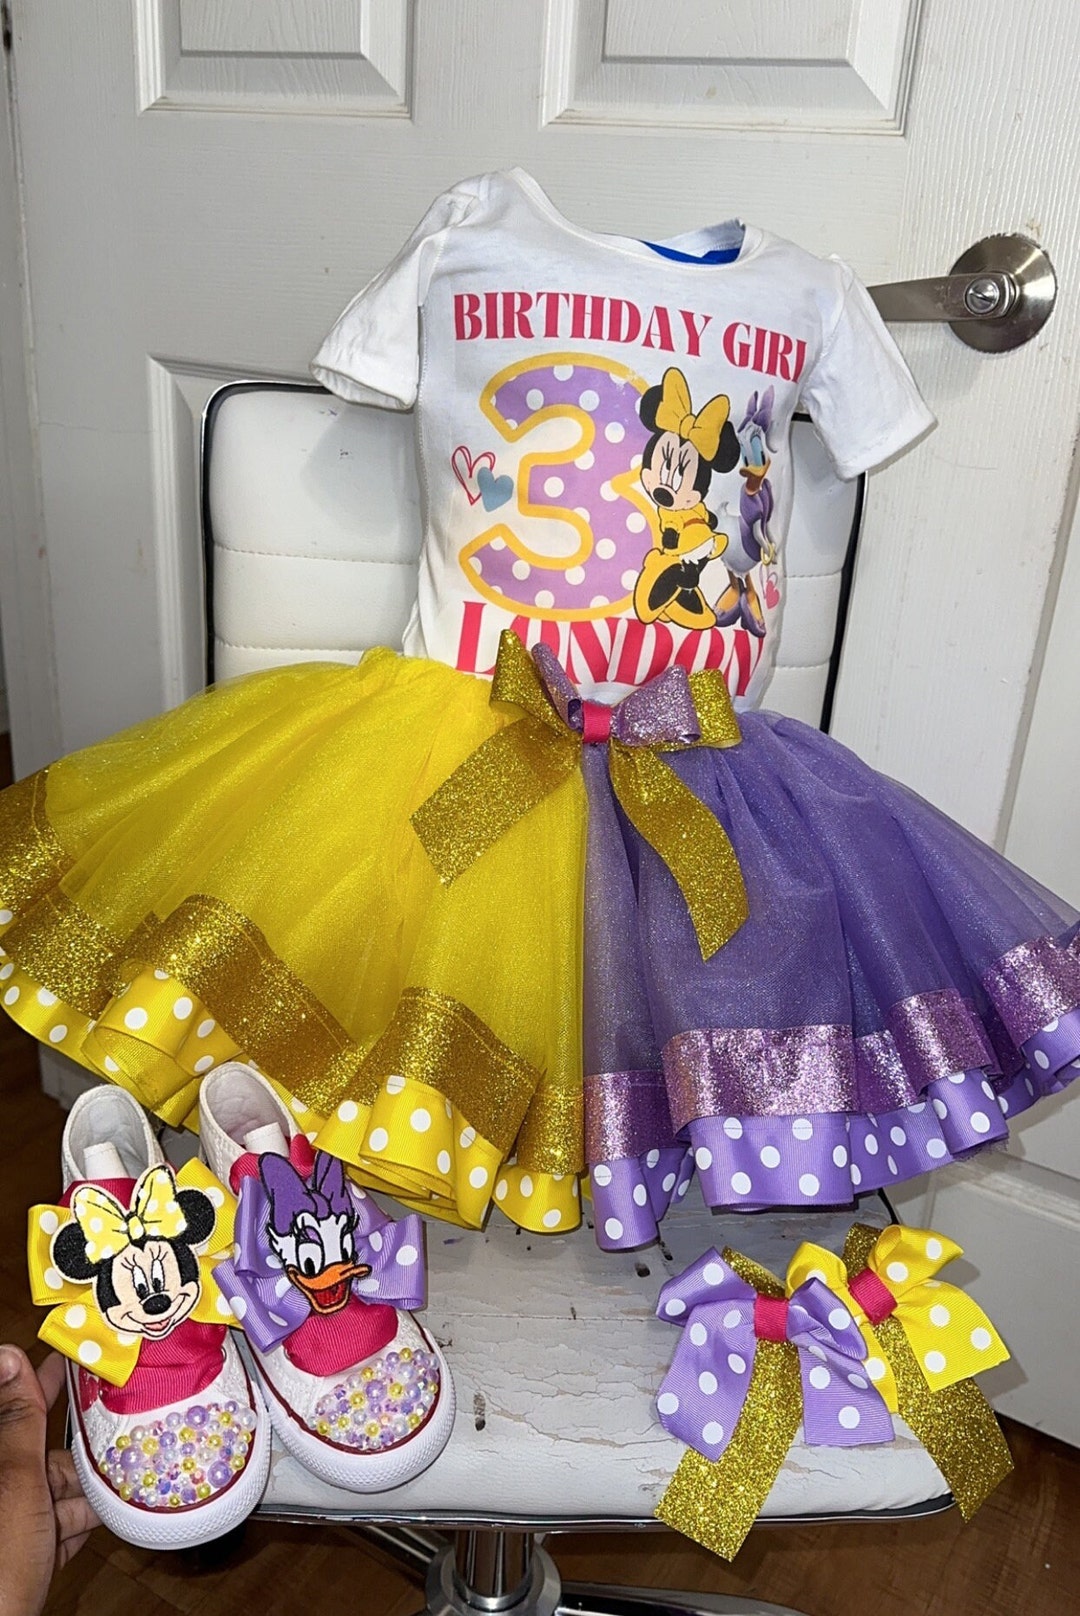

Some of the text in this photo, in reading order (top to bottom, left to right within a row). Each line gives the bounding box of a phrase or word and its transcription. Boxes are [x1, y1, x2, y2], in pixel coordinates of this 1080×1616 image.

[453, 291, 713, 357] BIRTHDAY
[458, 351, 661, 622] 3
[455, 600, 765, 697] LONDON
